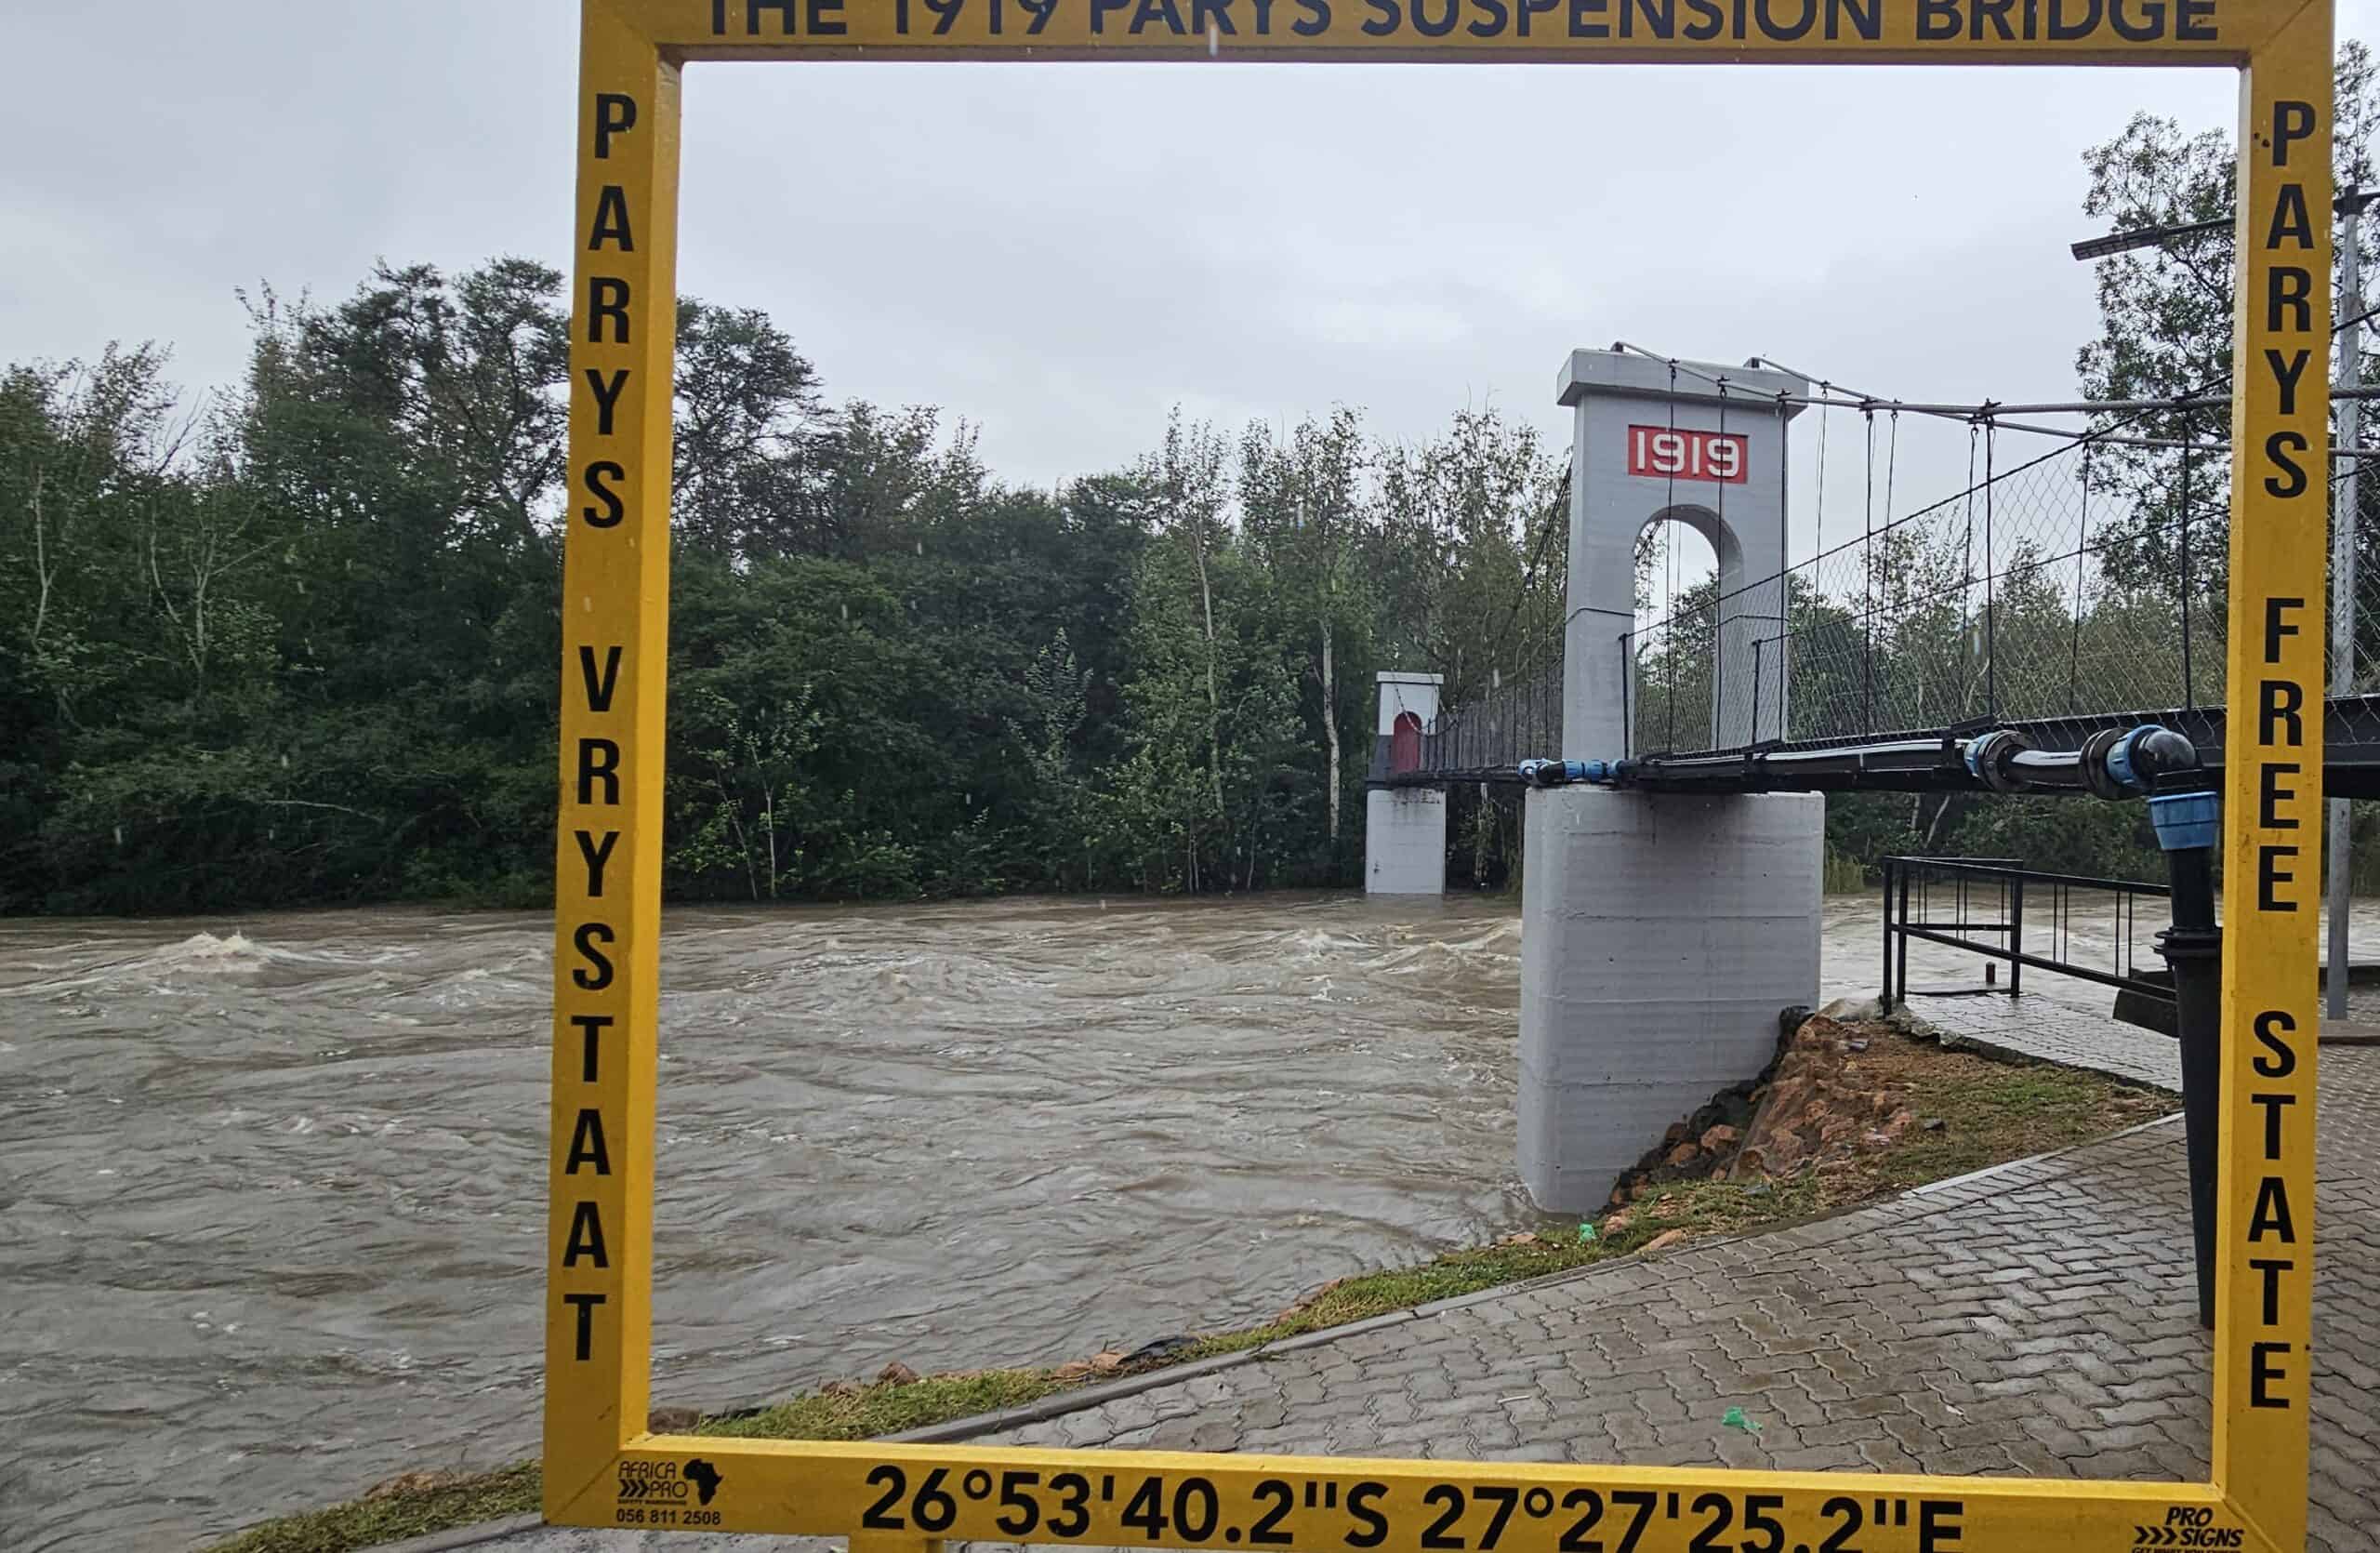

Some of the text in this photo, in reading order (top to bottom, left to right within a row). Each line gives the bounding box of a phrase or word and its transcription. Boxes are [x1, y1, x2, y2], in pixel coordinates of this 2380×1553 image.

[1091, 0, 1332, 36] PARYS
[1361, 0, 1882, 42] SUSPENSION
[1916, 0, 2218, 43] BRIDGE
[1636, 431, 1740, 478] 1919
[564, 94, 637, 1361] PARYS VRYSTAAT
[2248, 101, 2316, 1409] PARYS FREE STATE
[617, 1461, 677, 1480] AFRICA
[649, 1480, 689, 1498] PRO
[616, 1508, 721, 1526] 056 811 2508
[2165, 1507, 2214, 1526] PRO
[2179, 1528, 2246, 1547] SIGNS
